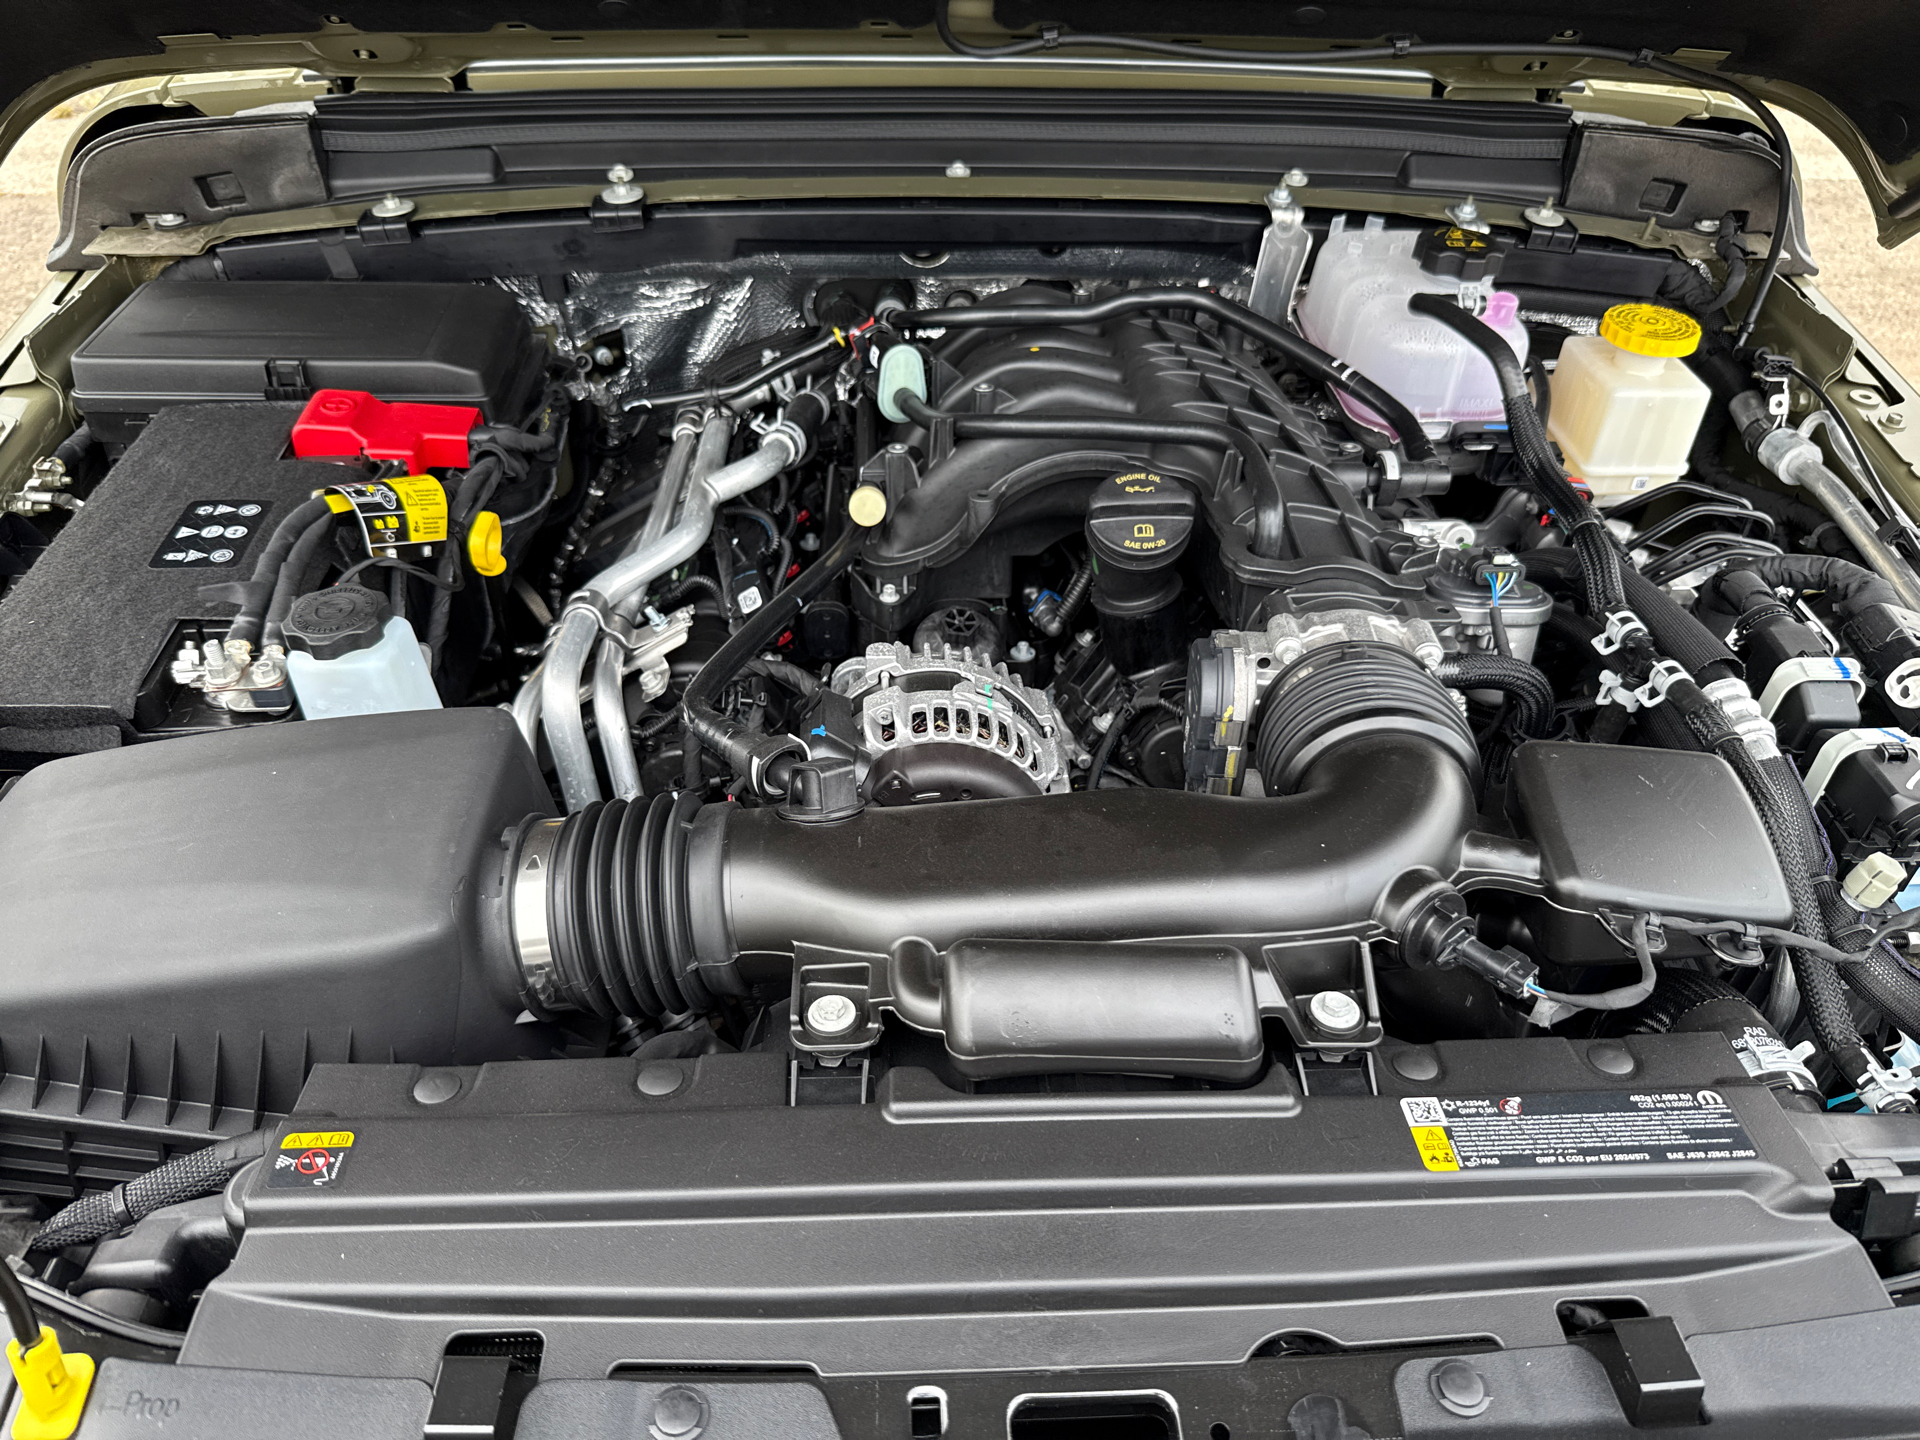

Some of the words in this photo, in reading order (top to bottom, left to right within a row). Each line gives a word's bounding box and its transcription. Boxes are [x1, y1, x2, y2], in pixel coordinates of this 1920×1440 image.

[1115, 473, 1147, 485] ENGINE
[1148, 474, 1161, 484] OIL
[1124, 539, 1141, 549] SAE
[1142, 539, 1166, 549] 0W-20
[1743, 1026, 1767, 1036] RAD
[1535, 1155, 1556, 1163] GWP
[1585, 1155, 1599, 1163] per
[1599, 1154, 1613, 1162] EU
[1666, 1151, 1685, 1159] SAE
[1481, 1157, 1500, 1165] PAG
